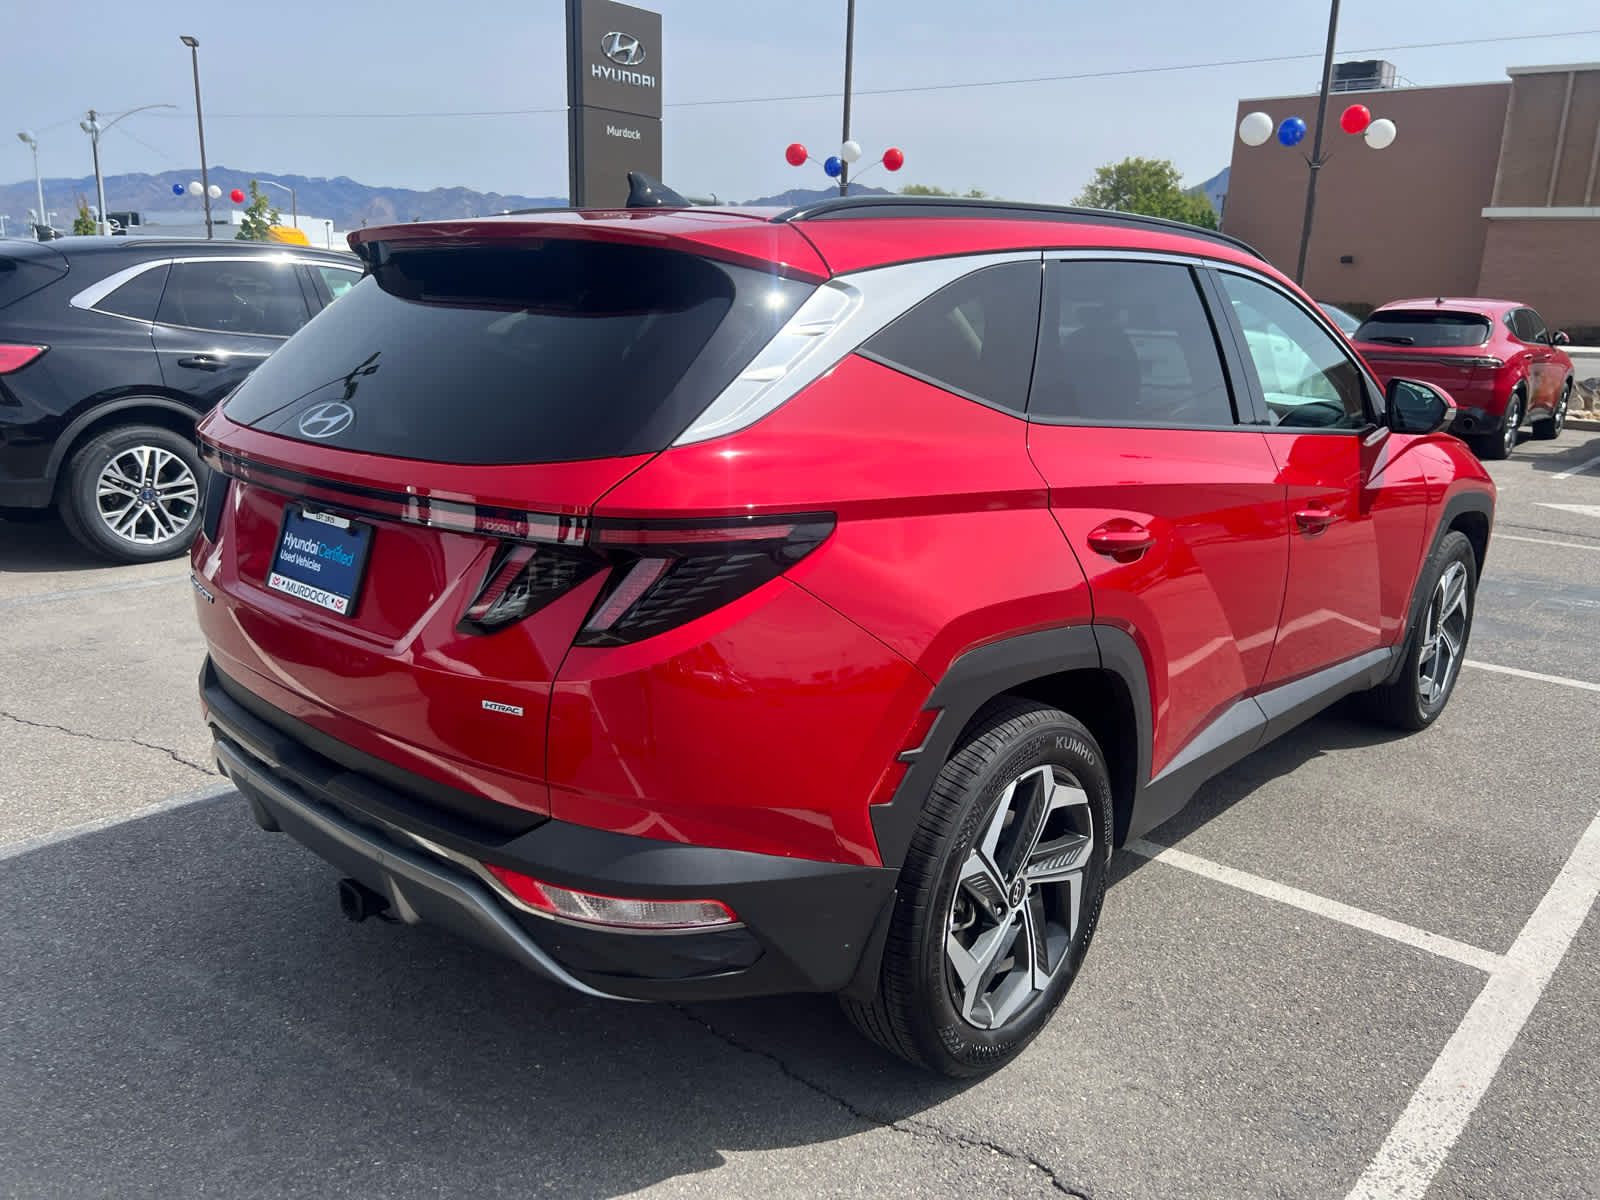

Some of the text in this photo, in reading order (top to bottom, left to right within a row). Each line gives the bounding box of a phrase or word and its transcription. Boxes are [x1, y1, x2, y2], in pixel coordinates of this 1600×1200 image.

[591, 63, 656, 88] HYUNDAI
[606, 125, 641, 140] Murdock
[280, 549, 322, 572] Used Vehicles
[283, 531, 355, 567] Hyundai Certified
[284, 580, 330, 606] MURDOCK
[484, 701, 521, 714] HTRAC
[1055, 735, 1095, 766] KUMHO
